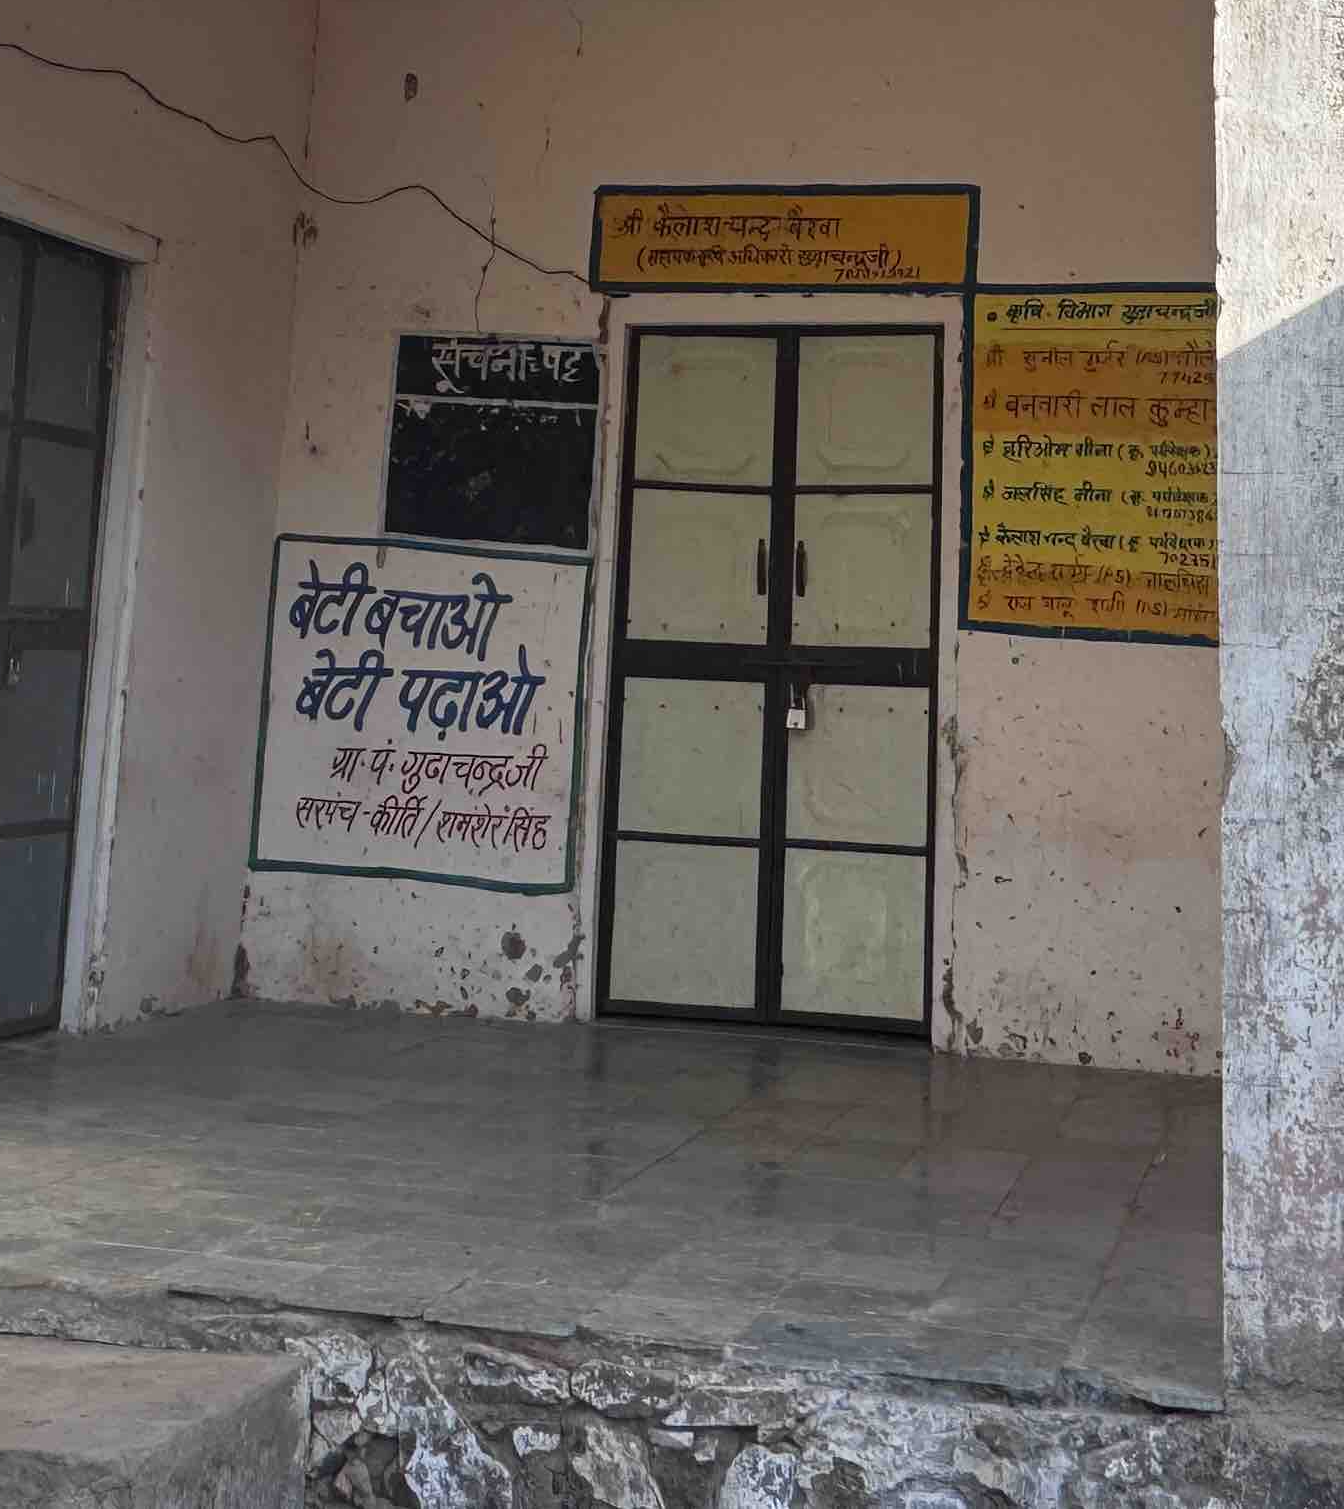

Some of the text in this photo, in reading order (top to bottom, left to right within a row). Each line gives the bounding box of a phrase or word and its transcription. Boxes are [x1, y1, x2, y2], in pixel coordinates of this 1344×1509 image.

[1005, 389, 1086, 419] बनवारी
[1090, 396, 1140, 419] लाल
[289, 559, 513, 662] बेटी बचाओ
[295, 648, 394, 732] बेटी
